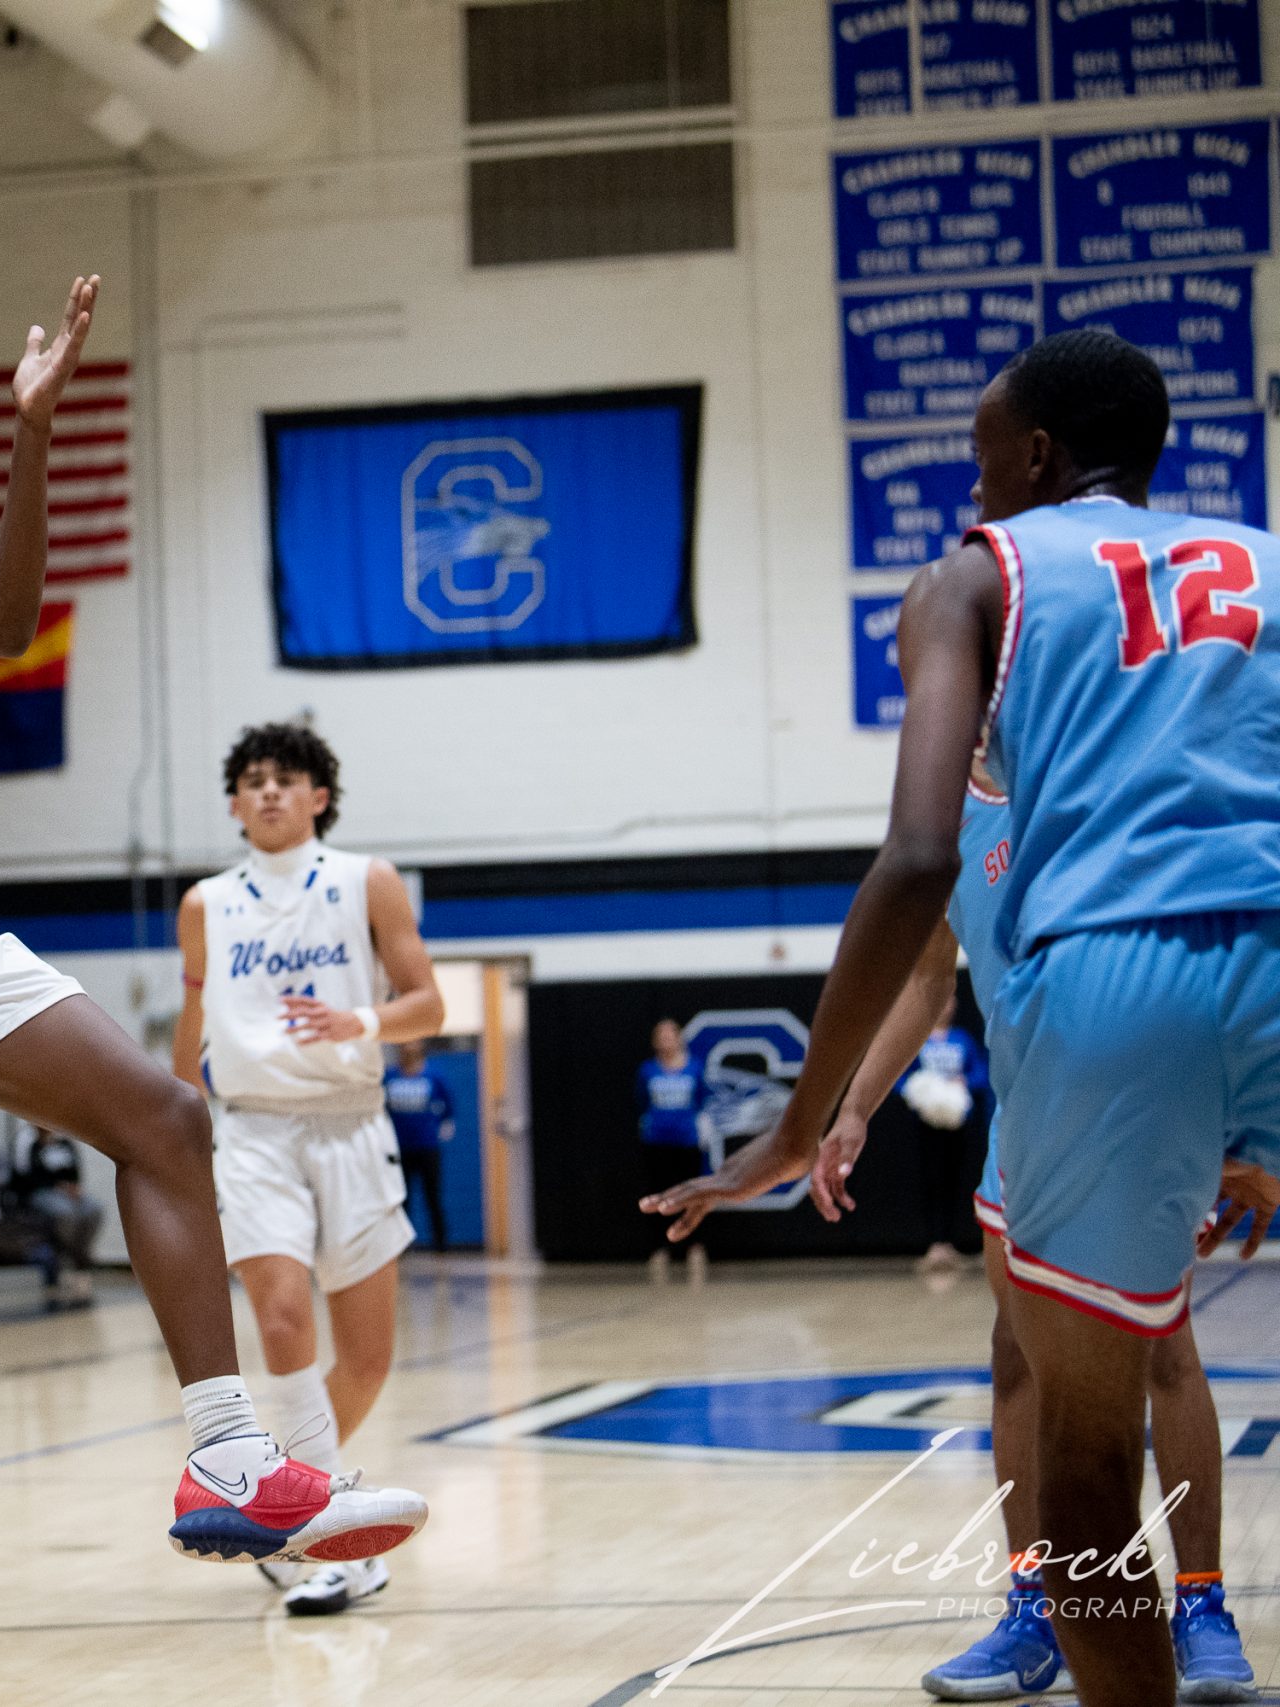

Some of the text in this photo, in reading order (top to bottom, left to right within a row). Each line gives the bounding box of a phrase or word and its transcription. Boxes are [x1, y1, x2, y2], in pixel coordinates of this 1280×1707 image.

[843, 151, 1032, 194] CHANDLER HIGH
[1068, 131, 1248, 178] CHANDLER HIGH
[1122, 203, 1205, 230] FOOTBALL
[857, 247, 910, 275] STATE
[918, 242, 989, 270] RUNNER
[1080, 228, 1245, 262] STATE CHAMPIONS
[848, 291, 1038, 336] CHANDLER HIGH
[1058, 274, 1241, 321] CHANDLER HIGH
[864, 390, 915, 416] STATE
[1191, 423, 1248, 458] HIGH
[874, 535, 926, 561] STATE
[1092, 539, 1263, 673] 12
[230, 938, 349, 978] Wolves
